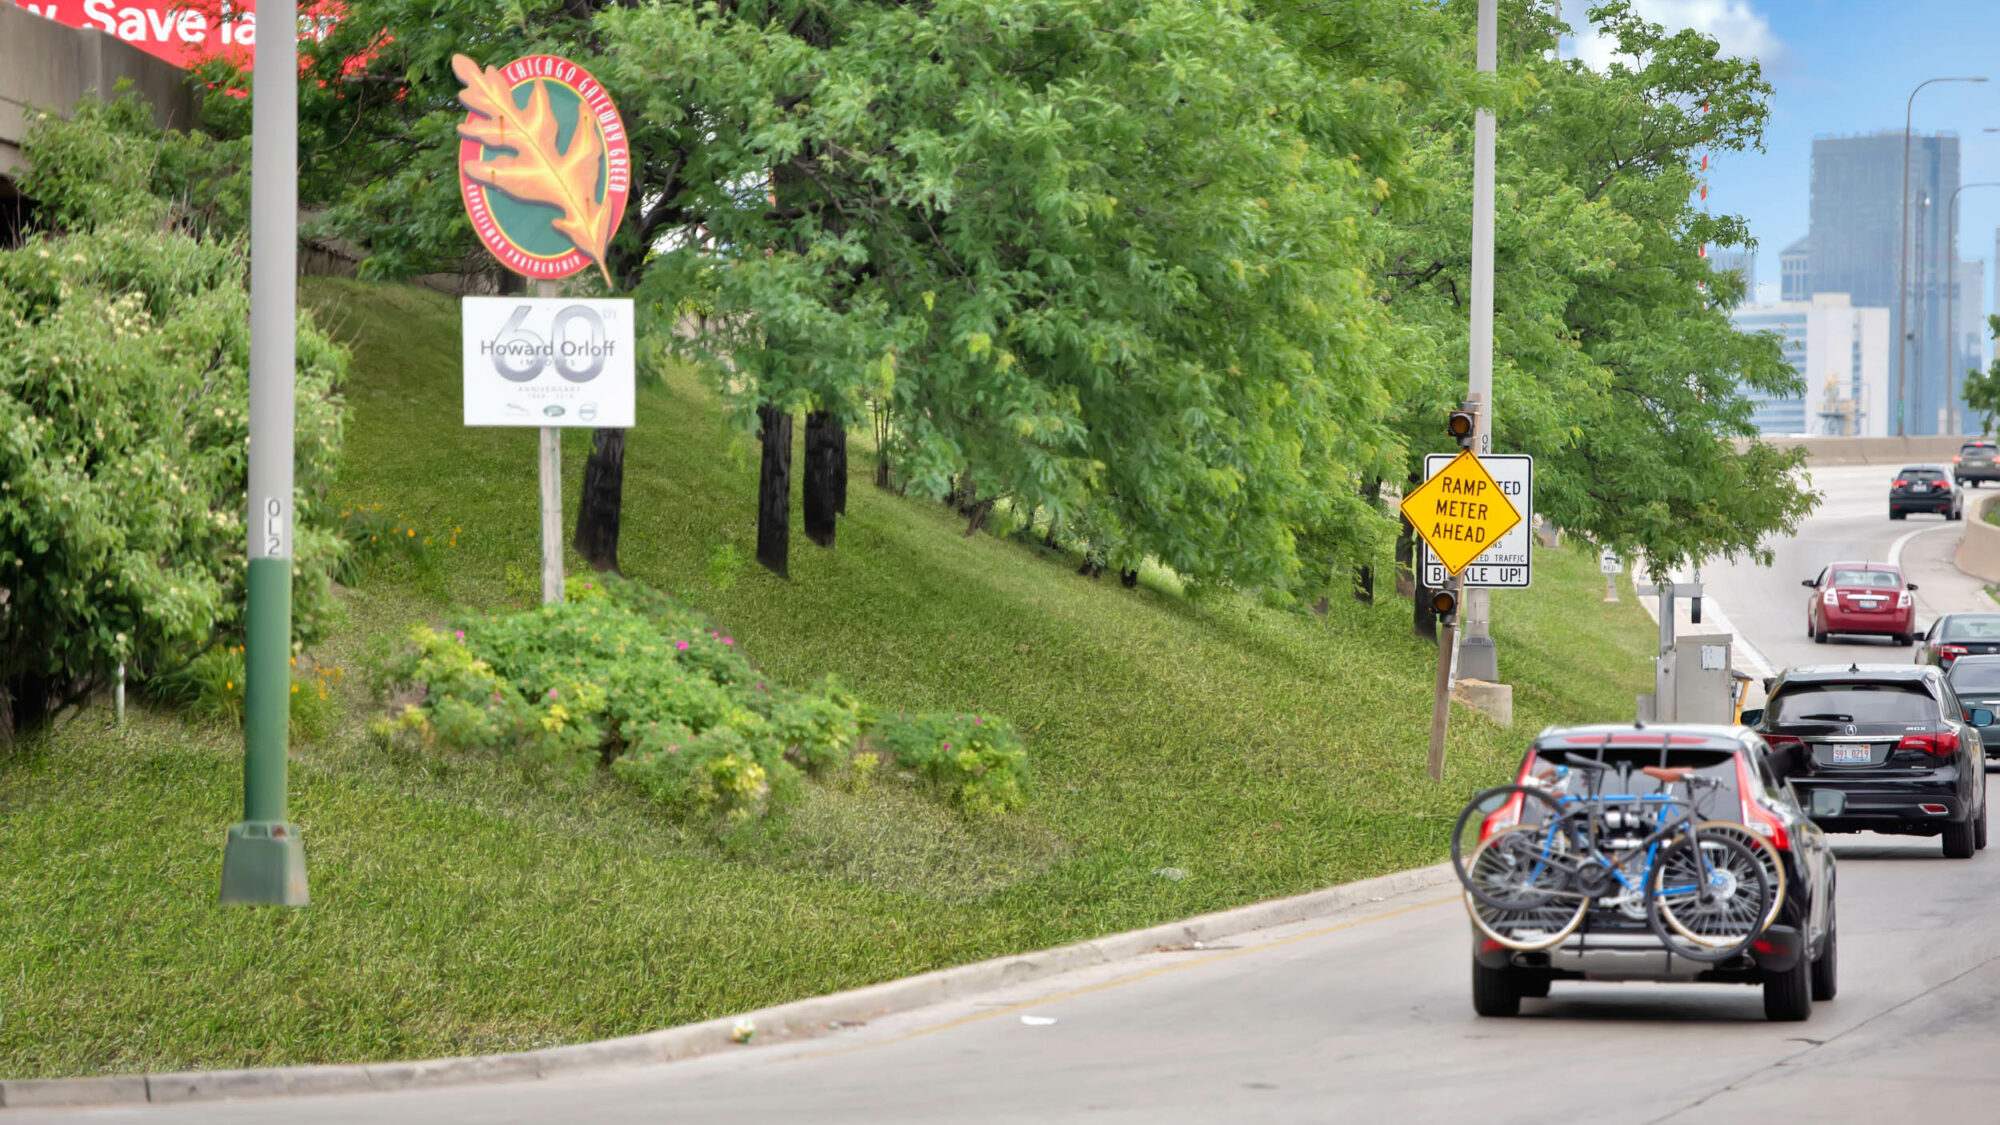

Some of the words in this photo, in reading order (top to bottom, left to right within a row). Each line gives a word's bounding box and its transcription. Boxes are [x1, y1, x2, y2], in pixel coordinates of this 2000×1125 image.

[83, 0, 207, 43] Save
[506, 58, 577, 82] CHICAGO
[578, 77, 624, 141] GATEWAY
[609, 148, 628, 192] GREEN
[467, 184, 505, 250] EXPRESSWAY
[506, 249, 580, 274] PARTNERSHIP
[481, 340, 554, 356] Howard
[560, 340, 615, 357] Orloff
[520, 359, 575, 367] IMOS
[1442, 477, 1487, 496] RAMP
[1435, 499, 1488, 520] METER
[1431, 522, 1486, 543] AHEAD
[1495, 554, 1525, 562] TRAFFIC
[1433, 567, 1488, 582] BKLE
[1500, 567, 1521, 582] UP!
